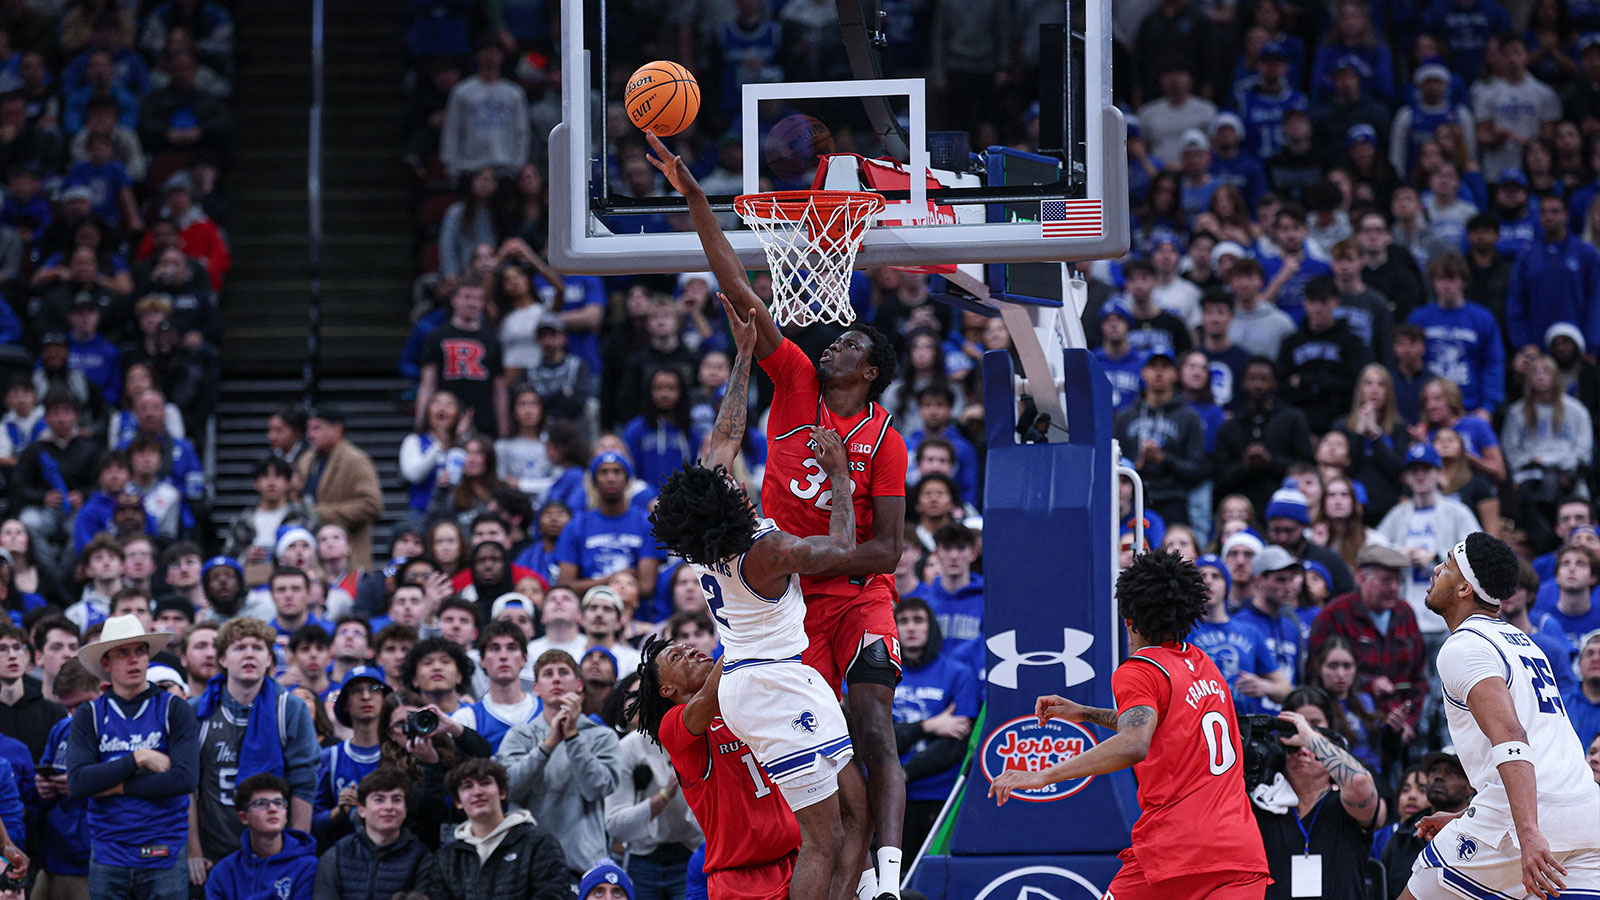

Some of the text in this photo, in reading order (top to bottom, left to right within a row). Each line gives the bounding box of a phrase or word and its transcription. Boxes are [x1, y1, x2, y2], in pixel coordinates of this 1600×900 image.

[631, 99, 652, 122] EVO
[441, 338, 489, 381] R
[700, 573, 732, 631] 2
[1518, 655, 1566, 717] 25
[215, 741, 238, 762] The
[998, 732, 1083, 759] Jersey
[1201, 711, 1237, 776] 0
[741, 752, 772, 799] 1
